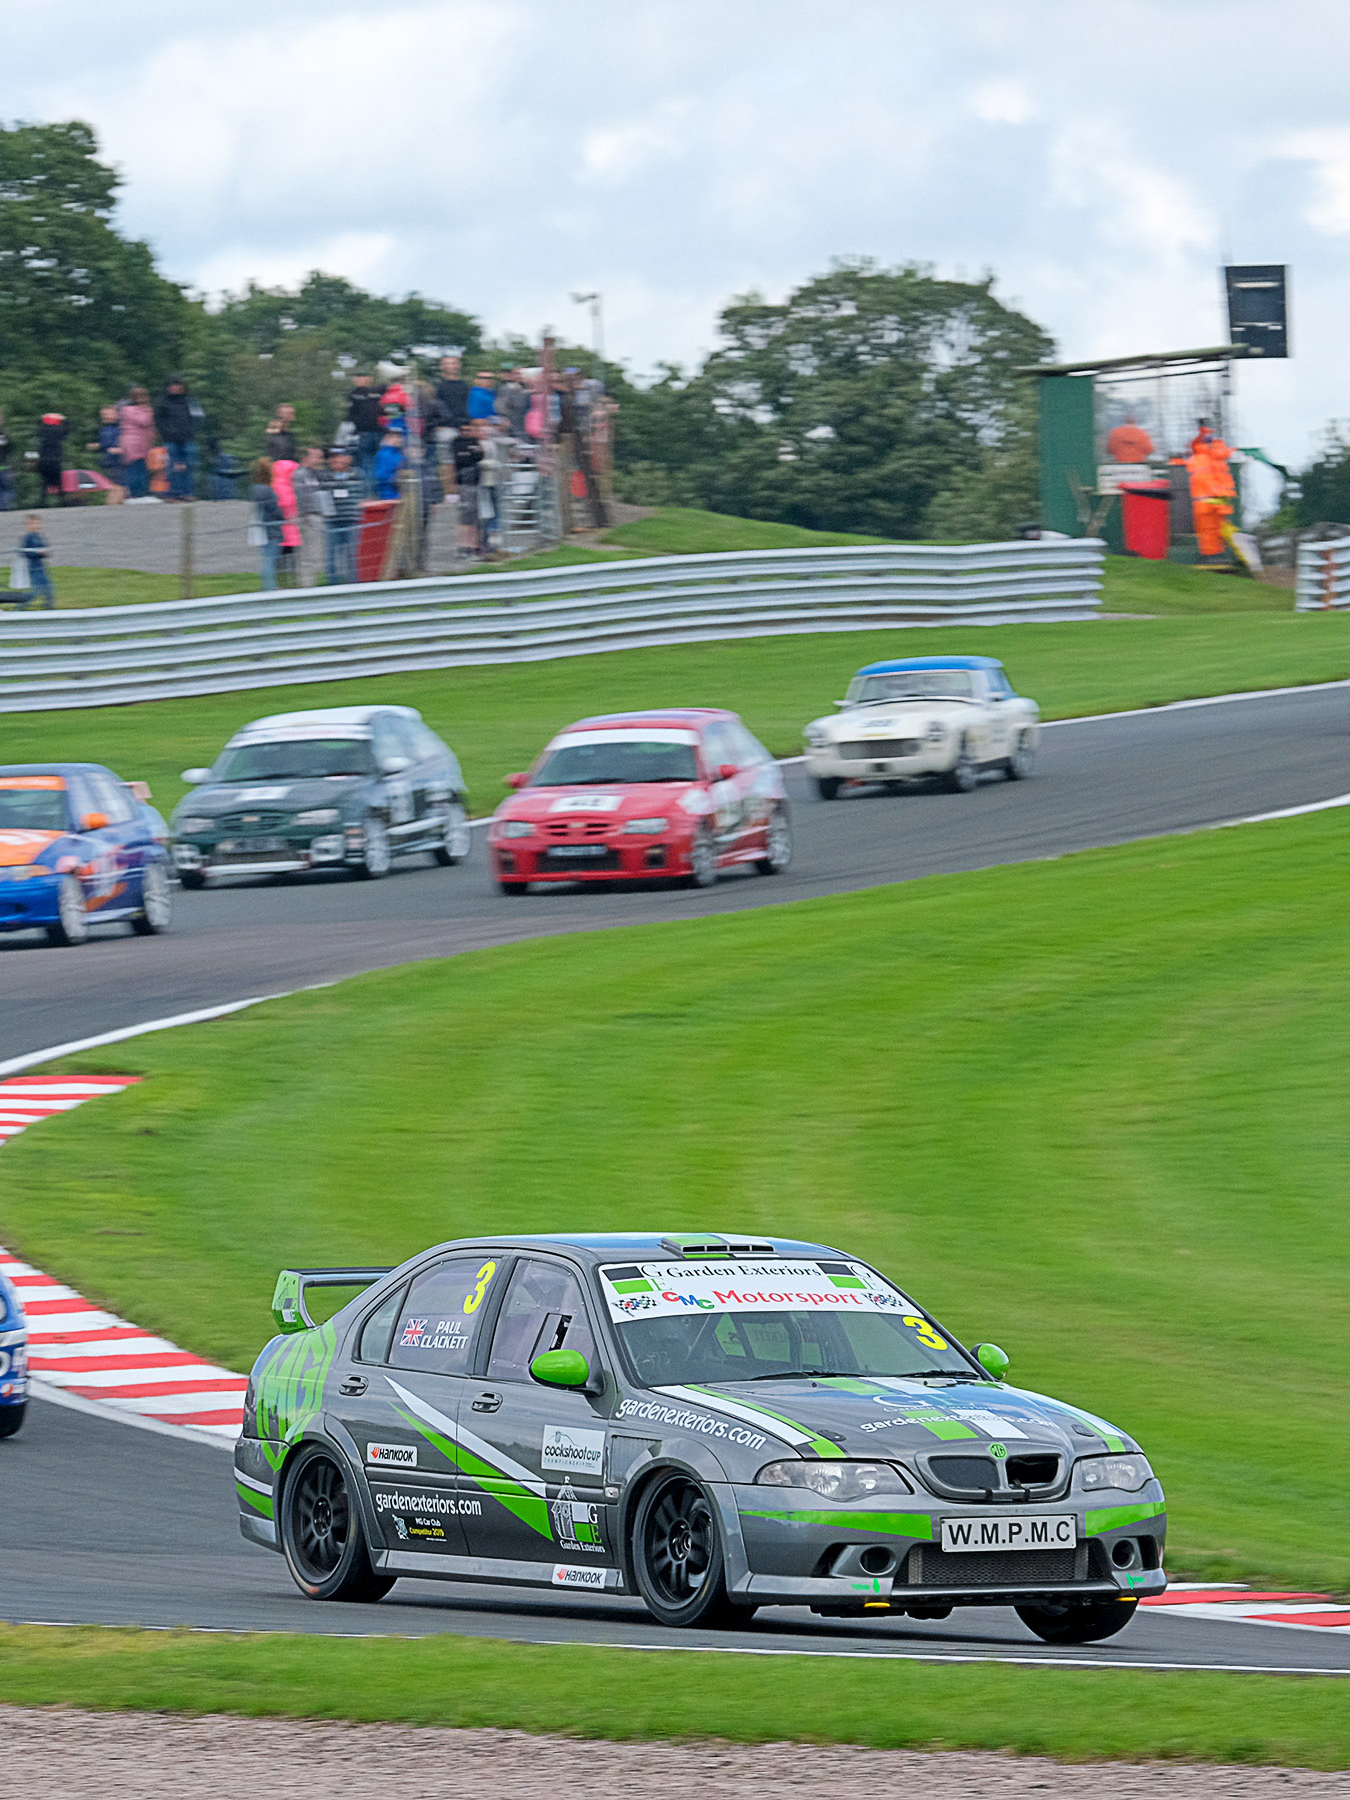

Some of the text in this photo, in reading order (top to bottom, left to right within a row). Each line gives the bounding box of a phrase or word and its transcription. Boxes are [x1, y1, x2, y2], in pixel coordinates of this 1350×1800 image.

[666, 1264, 823, 1280] Garden Exteriors
[462, 1260, 497, 1315] 3
[661, 1290, 715, 1310] CMC
[712, 1289, 864, 1307] Motorsport
[435, 1320, 462, 1335] PAUL
[902, 1315, 949, 1351] 3
[419, 1335, 469, 1350] CLACKETT
[615, 1399, 768, 1451] gardenexteriors.com
[989, 1443, 1007, 1458] MG
[375, 1491, 483, 1516] gardenexteriors.com
[587, 1503, 599, 1524] G
[591, 1523, 602, 1544] E
[947, 1520, 1072, 1546] W.M.P.M.C
[559, 1539, 606, 1553] Garden Exteriors
